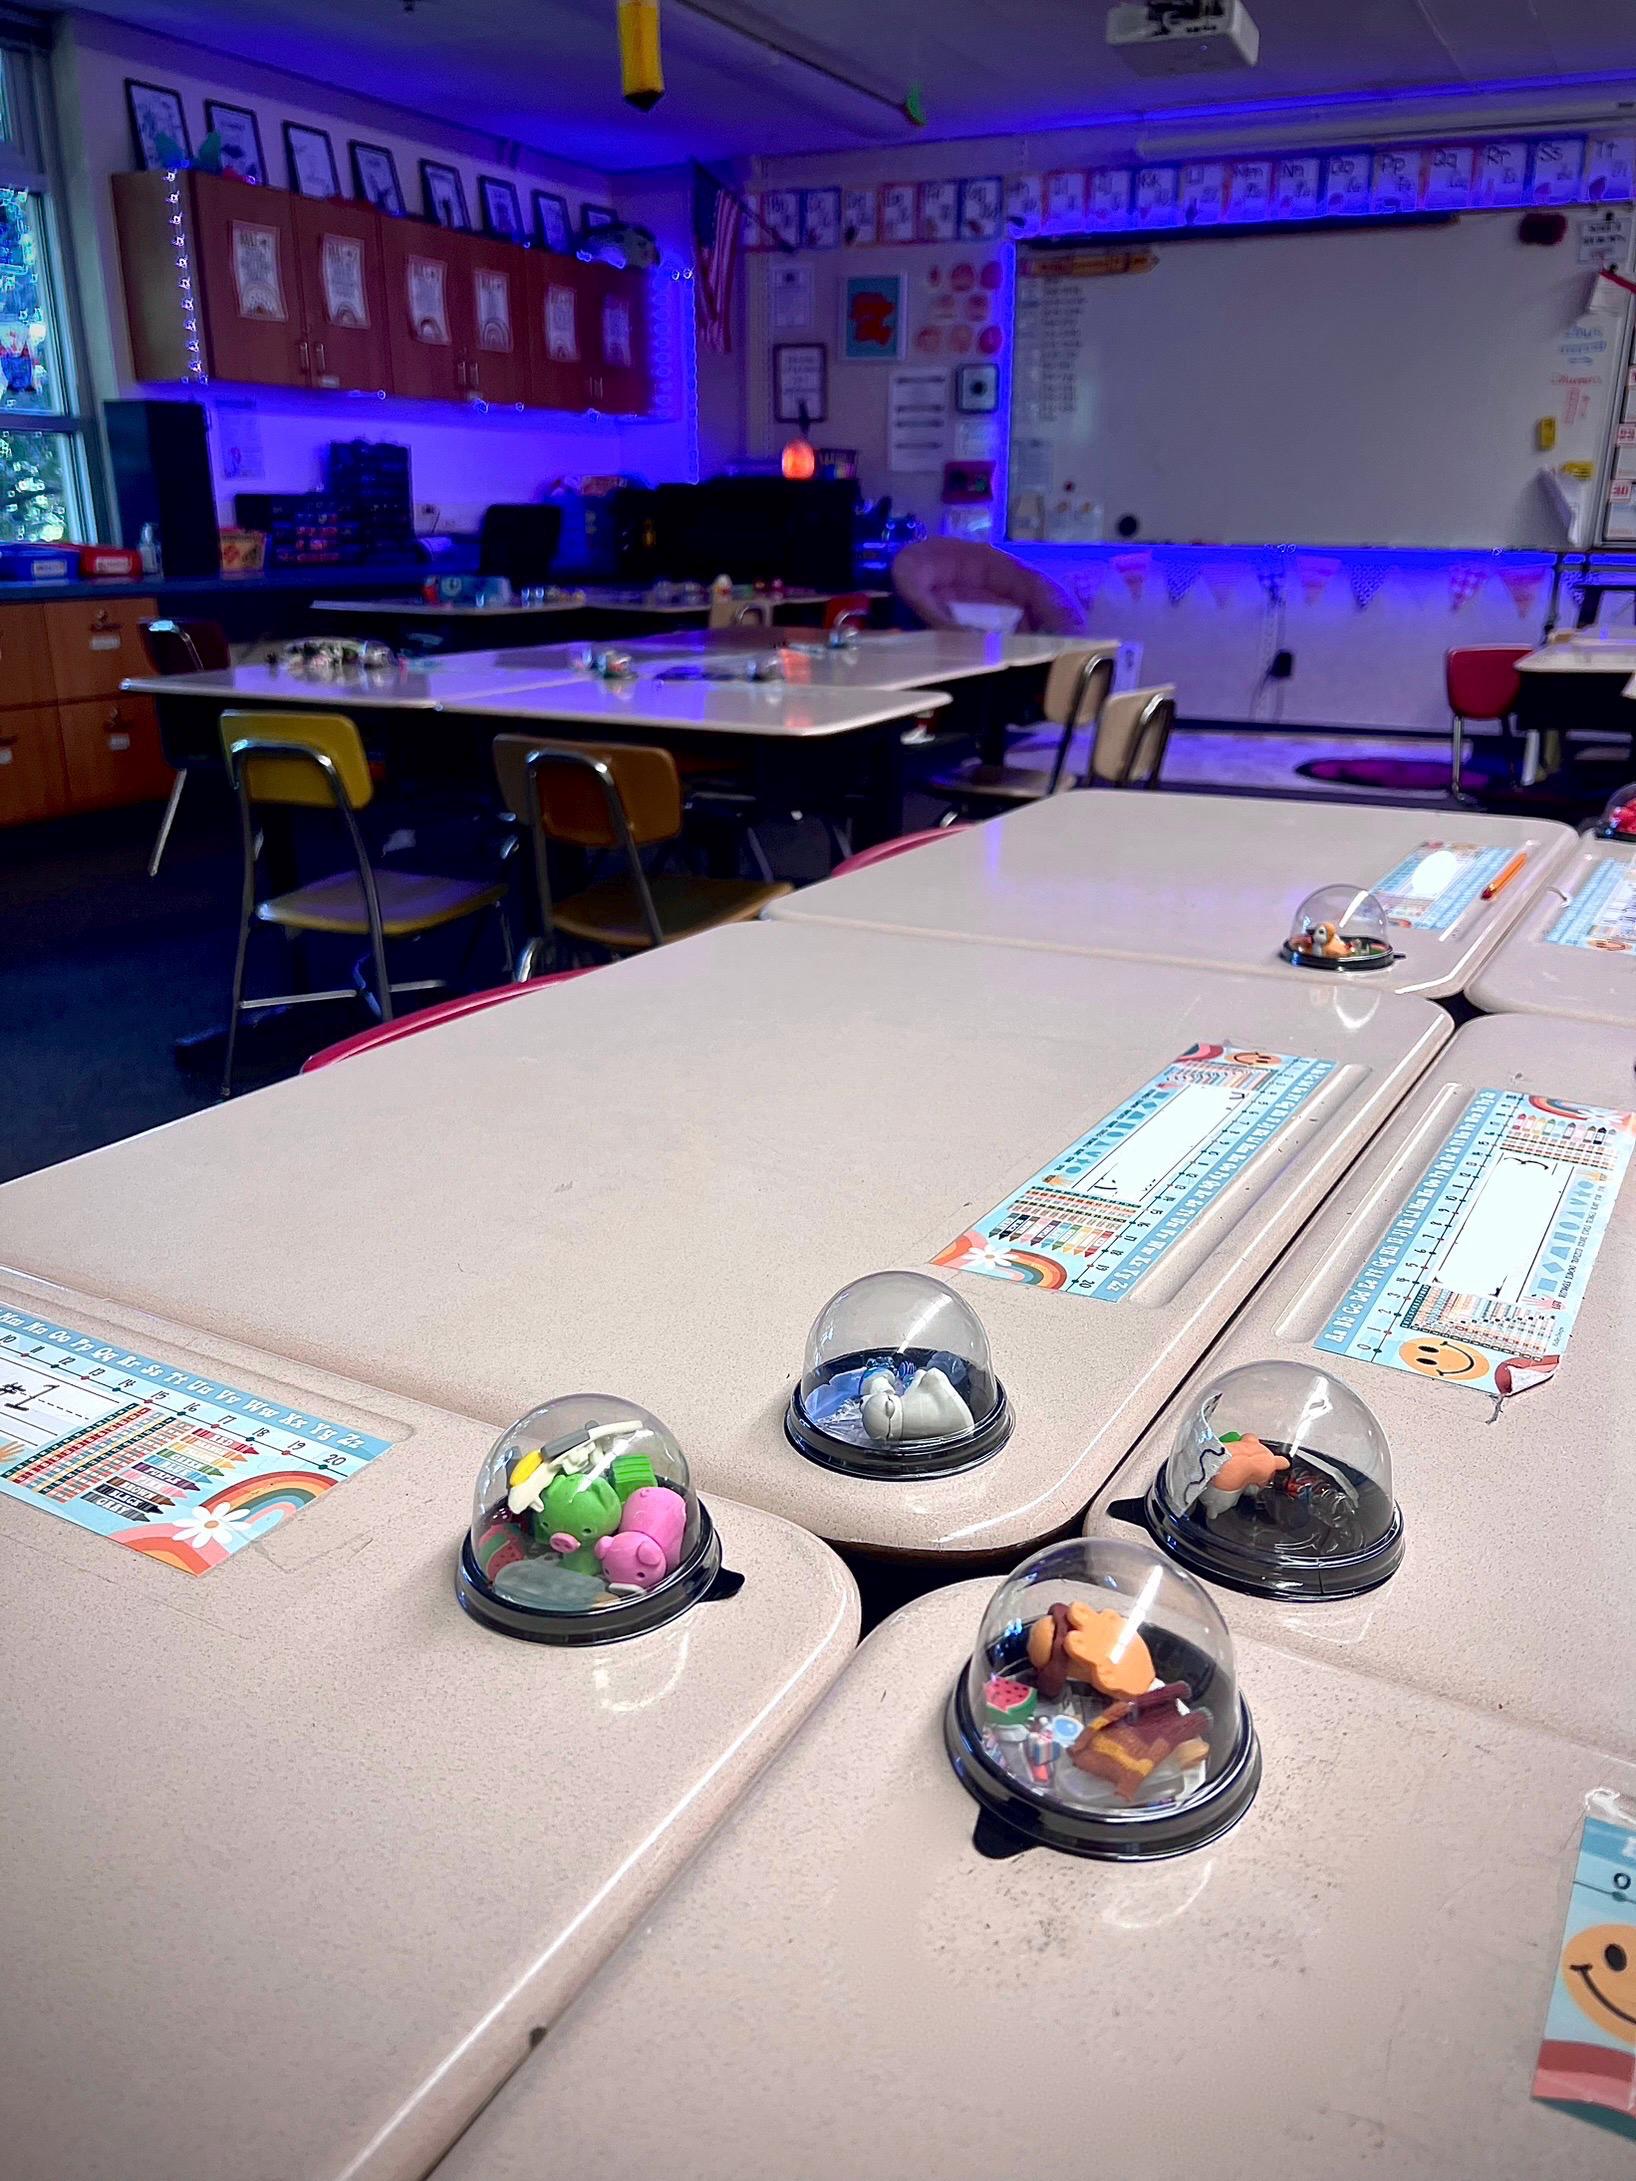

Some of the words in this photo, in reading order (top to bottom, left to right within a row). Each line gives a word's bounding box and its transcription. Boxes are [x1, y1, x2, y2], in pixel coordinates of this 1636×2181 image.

[23, 1319, 48, 1334] Nn
[48, 1330, 71, 1343] Oo
[70, 1338, 95, 1352] Pp
[91, 1347, 118, 1362] Qq
[117, 1356, 142, 1368] Rr
[141, 1364, 164, 1377] Ss
[164, 1372, 188, 1386] Tt
[187, 1380, 214, 1395] Uu
[215, 1389, 242, 1404] Vv
[243, 1399, 280, 1418] Ww
[278, 1413, 308, 1429] Xx
[310, 1423, 339, 1441] Yy
[337, 1433, 366, 1449] Zz
[1, 1334, 17, 1344] 10
[30, 1346, 46, 1354] 11
[58, 1356, 76, 1366] 12
[88, 1367, 107, 1377] 13
[117, 1378, 137, 1388] 14
[150, 1390, 170, 1400] 15
[183, 1402, 202, 1413] 16
[217, 1415, 238, 1425] 17
[251, 1427, 271, 1437] 18
[287, 1440, 307, 1451] 19
[323, 1453, 347, 1466] 20
[144, 1468, 183, 1484] PURPLE
[108, 1489, 141, 1507] BLACK
[121, 1481, 158, 1499] BROWN
[95, 1498, 129, 1516] GRAY
[1614, 1873, 1631, 1890] 0
